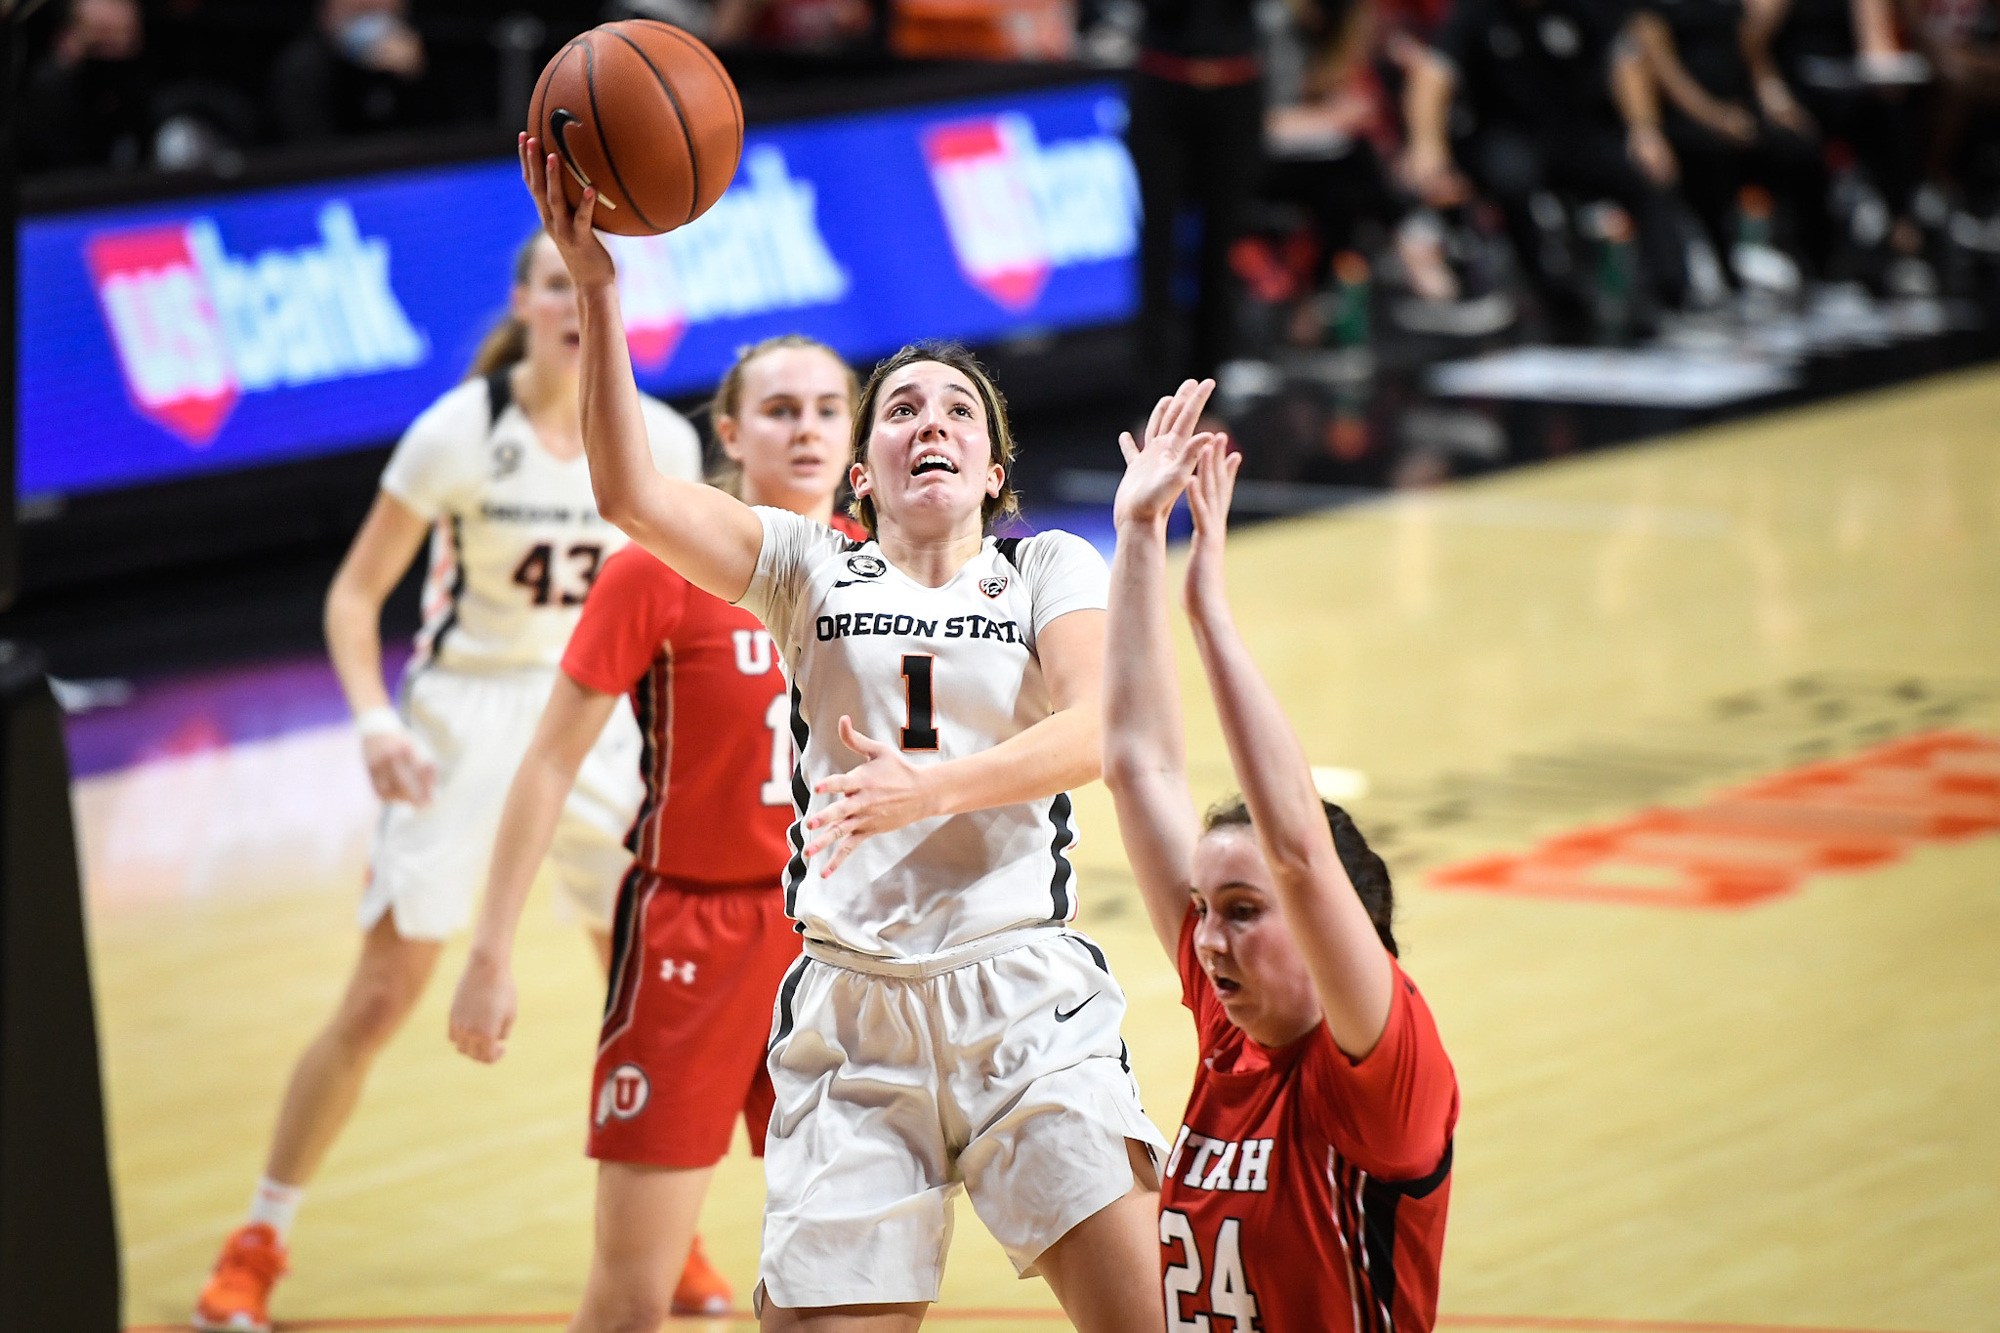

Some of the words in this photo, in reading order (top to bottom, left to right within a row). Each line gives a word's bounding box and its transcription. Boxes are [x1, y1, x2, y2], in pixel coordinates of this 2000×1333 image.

[510, 542, 604, 606] 43
[816, 612, 939, 642] OREGON
[901, 654, 940, 751] 1
[1159, 1207, 1266, 1333] 24
